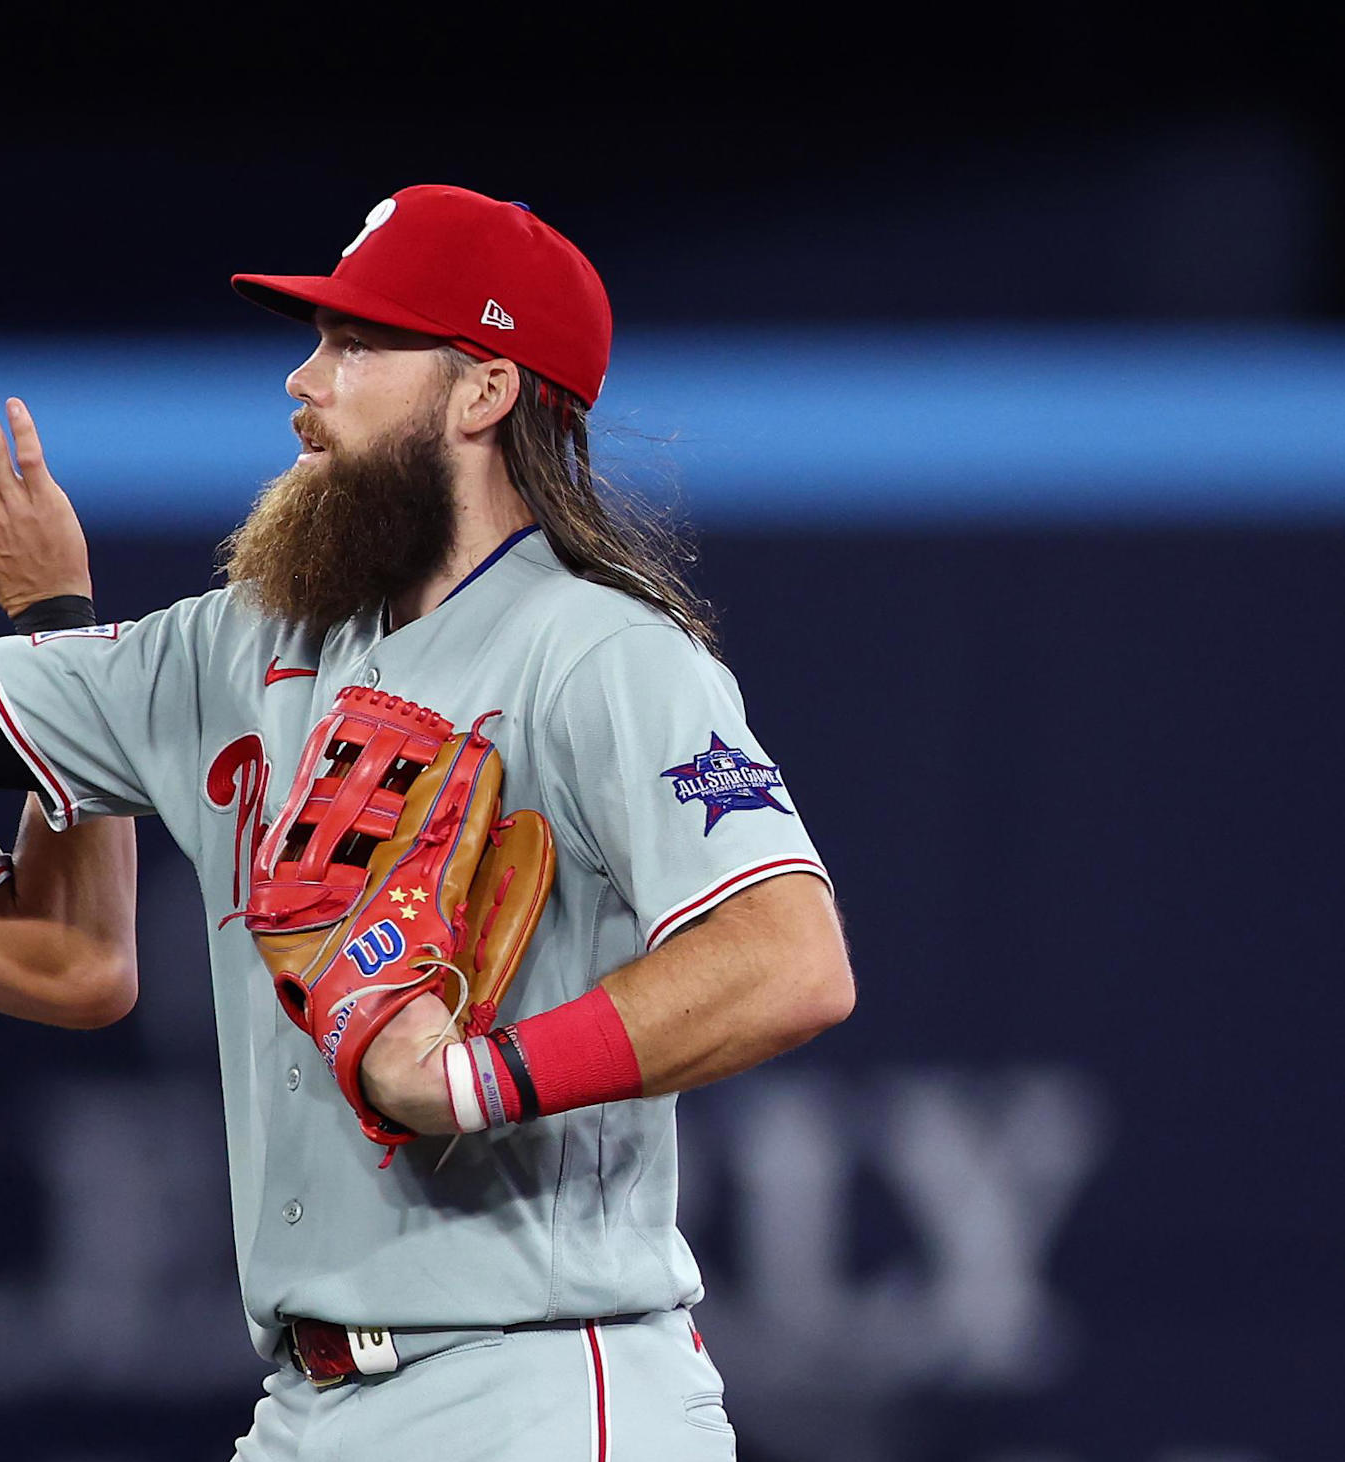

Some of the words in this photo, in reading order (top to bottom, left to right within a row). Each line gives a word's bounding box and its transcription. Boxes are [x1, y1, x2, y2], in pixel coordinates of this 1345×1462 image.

[677, 776, 708, 799] ALL
[704, 769, 743, 789] STAR
[742, 766, 779, 784] GAME
